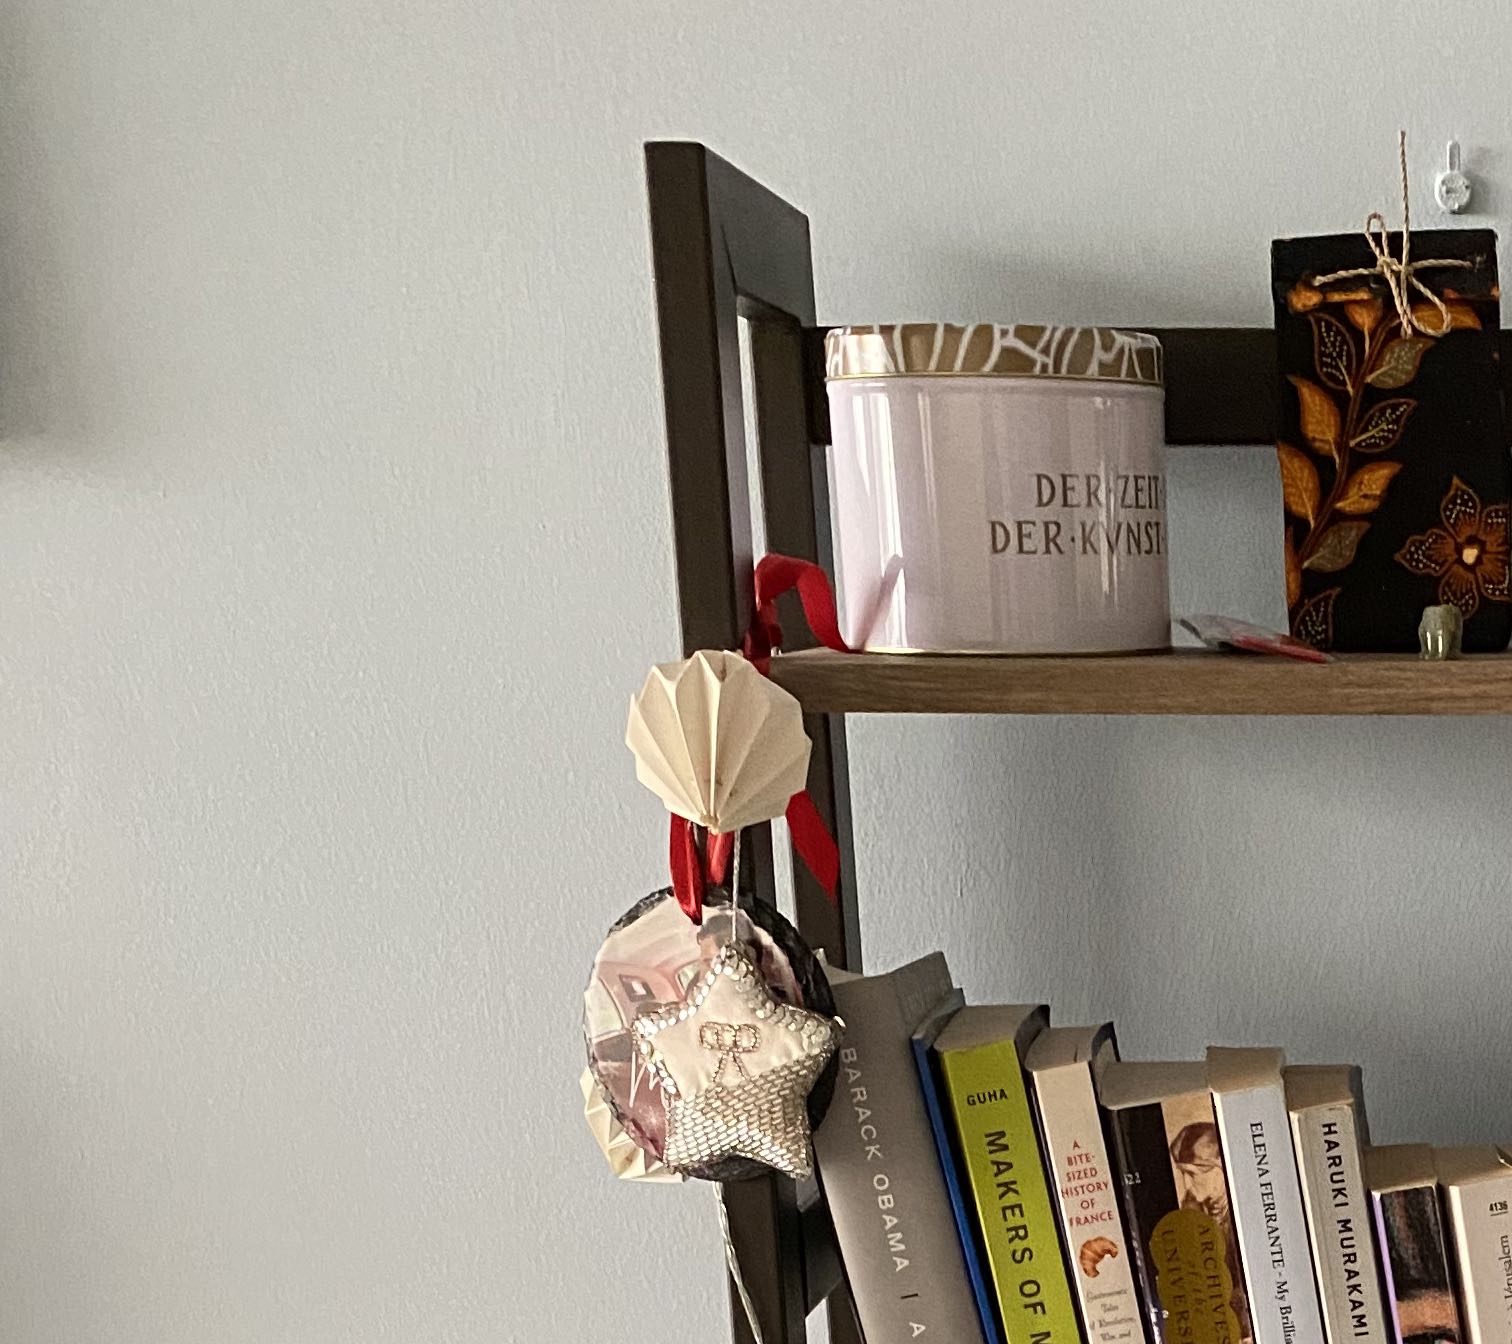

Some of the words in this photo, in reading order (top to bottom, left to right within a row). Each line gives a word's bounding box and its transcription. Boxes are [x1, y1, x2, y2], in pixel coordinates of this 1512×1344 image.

[966, 1088, 1008, 1106] GUHA
[840, 1047, 883, 1160] BARACK
[872, 1173, 910, 1272] OBAMA
[1066, 1166, 1098, 1183] SIZED
[1061, 1181, 1109, 1199] HISTORY
[1080, 1197, 1096, 1210] OF
[1250, 1121, 1268, 1179] ELENA
[1260, 1181, 1285, 1269] FERRANTE
[1275, 1280, 1288, 1303] My
[984, 1129, 1034, 1264] MAKERS
[1019, 1278, 1047, 1316] OF
[1069, 1210, 1114, 1227] FRANCE
[1322, 1121, 1350, 1208] HARUKI
[1336, 1216, 1370, 1338] MURAKAMI
[909, 1321, 926, 1338] A
